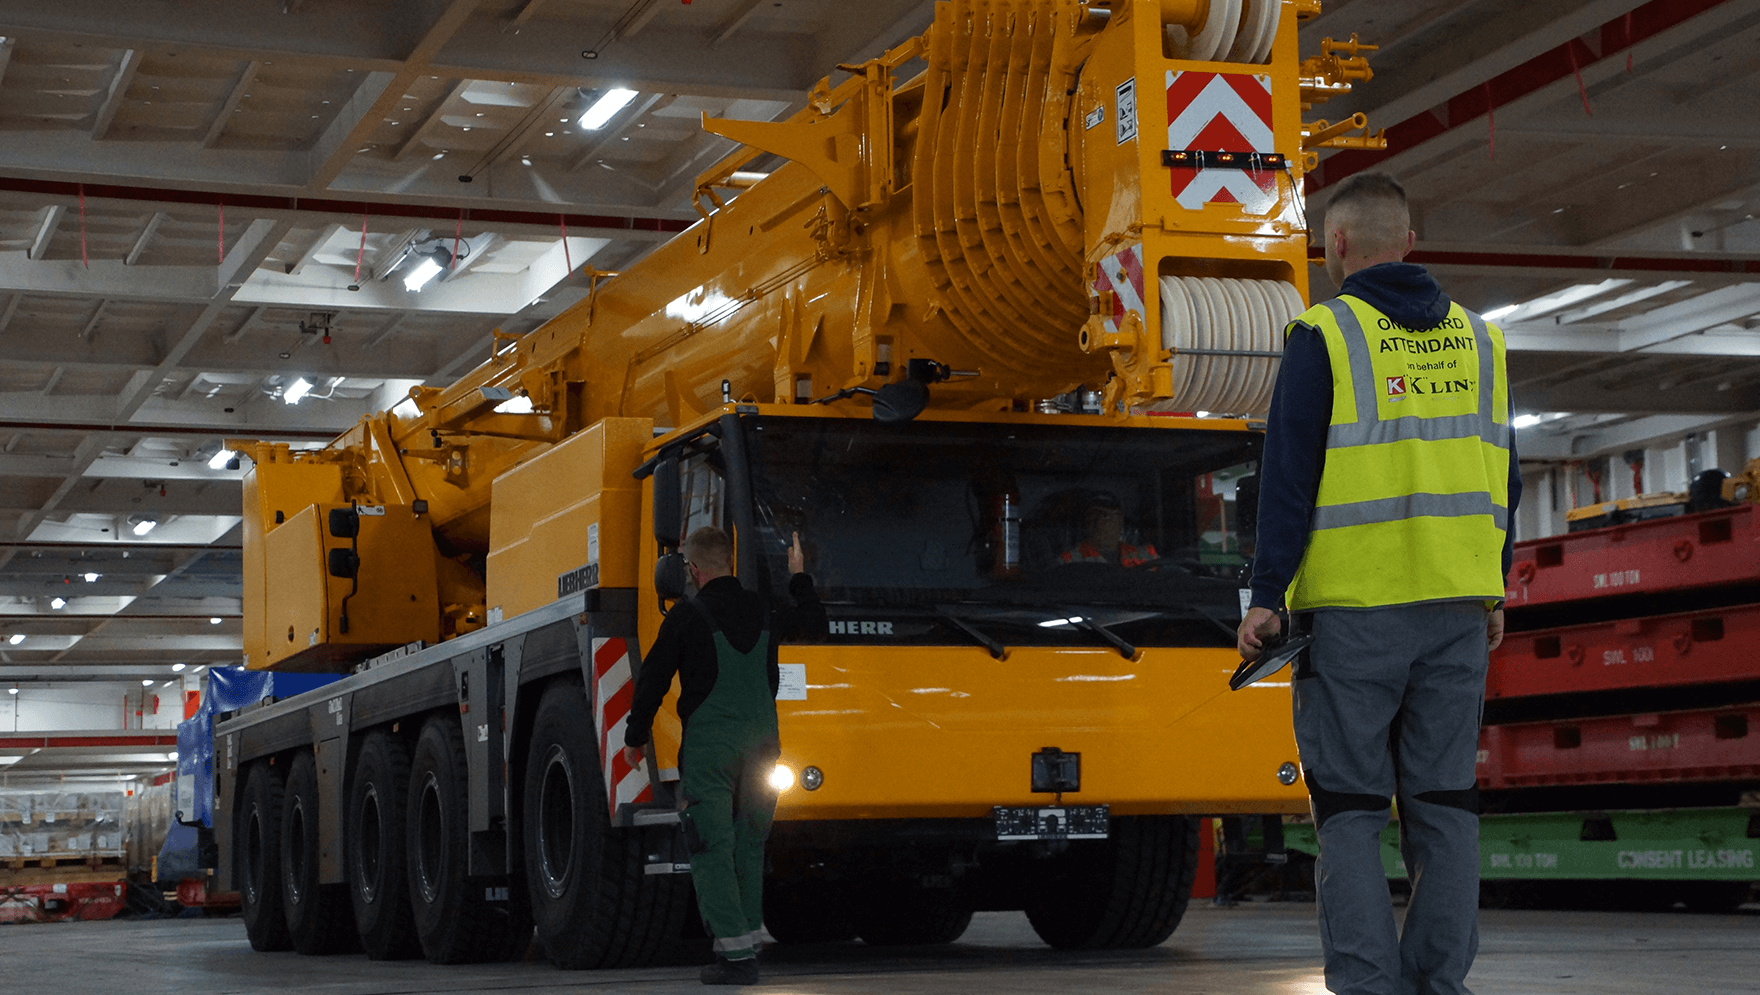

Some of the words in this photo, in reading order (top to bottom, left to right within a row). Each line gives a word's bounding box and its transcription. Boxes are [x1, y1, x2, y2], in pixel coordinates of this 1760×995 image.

[1379, 336, 1474, 354] ATTENDANT
[1416, 361, 1445, 371] behalf
[1447, 359, 1457, 369] of
[829, 620, 894, 635] HERR
[1618, 850, 1682, 868] CONSENT
[1688, 850, 1754, 868] LEASING
